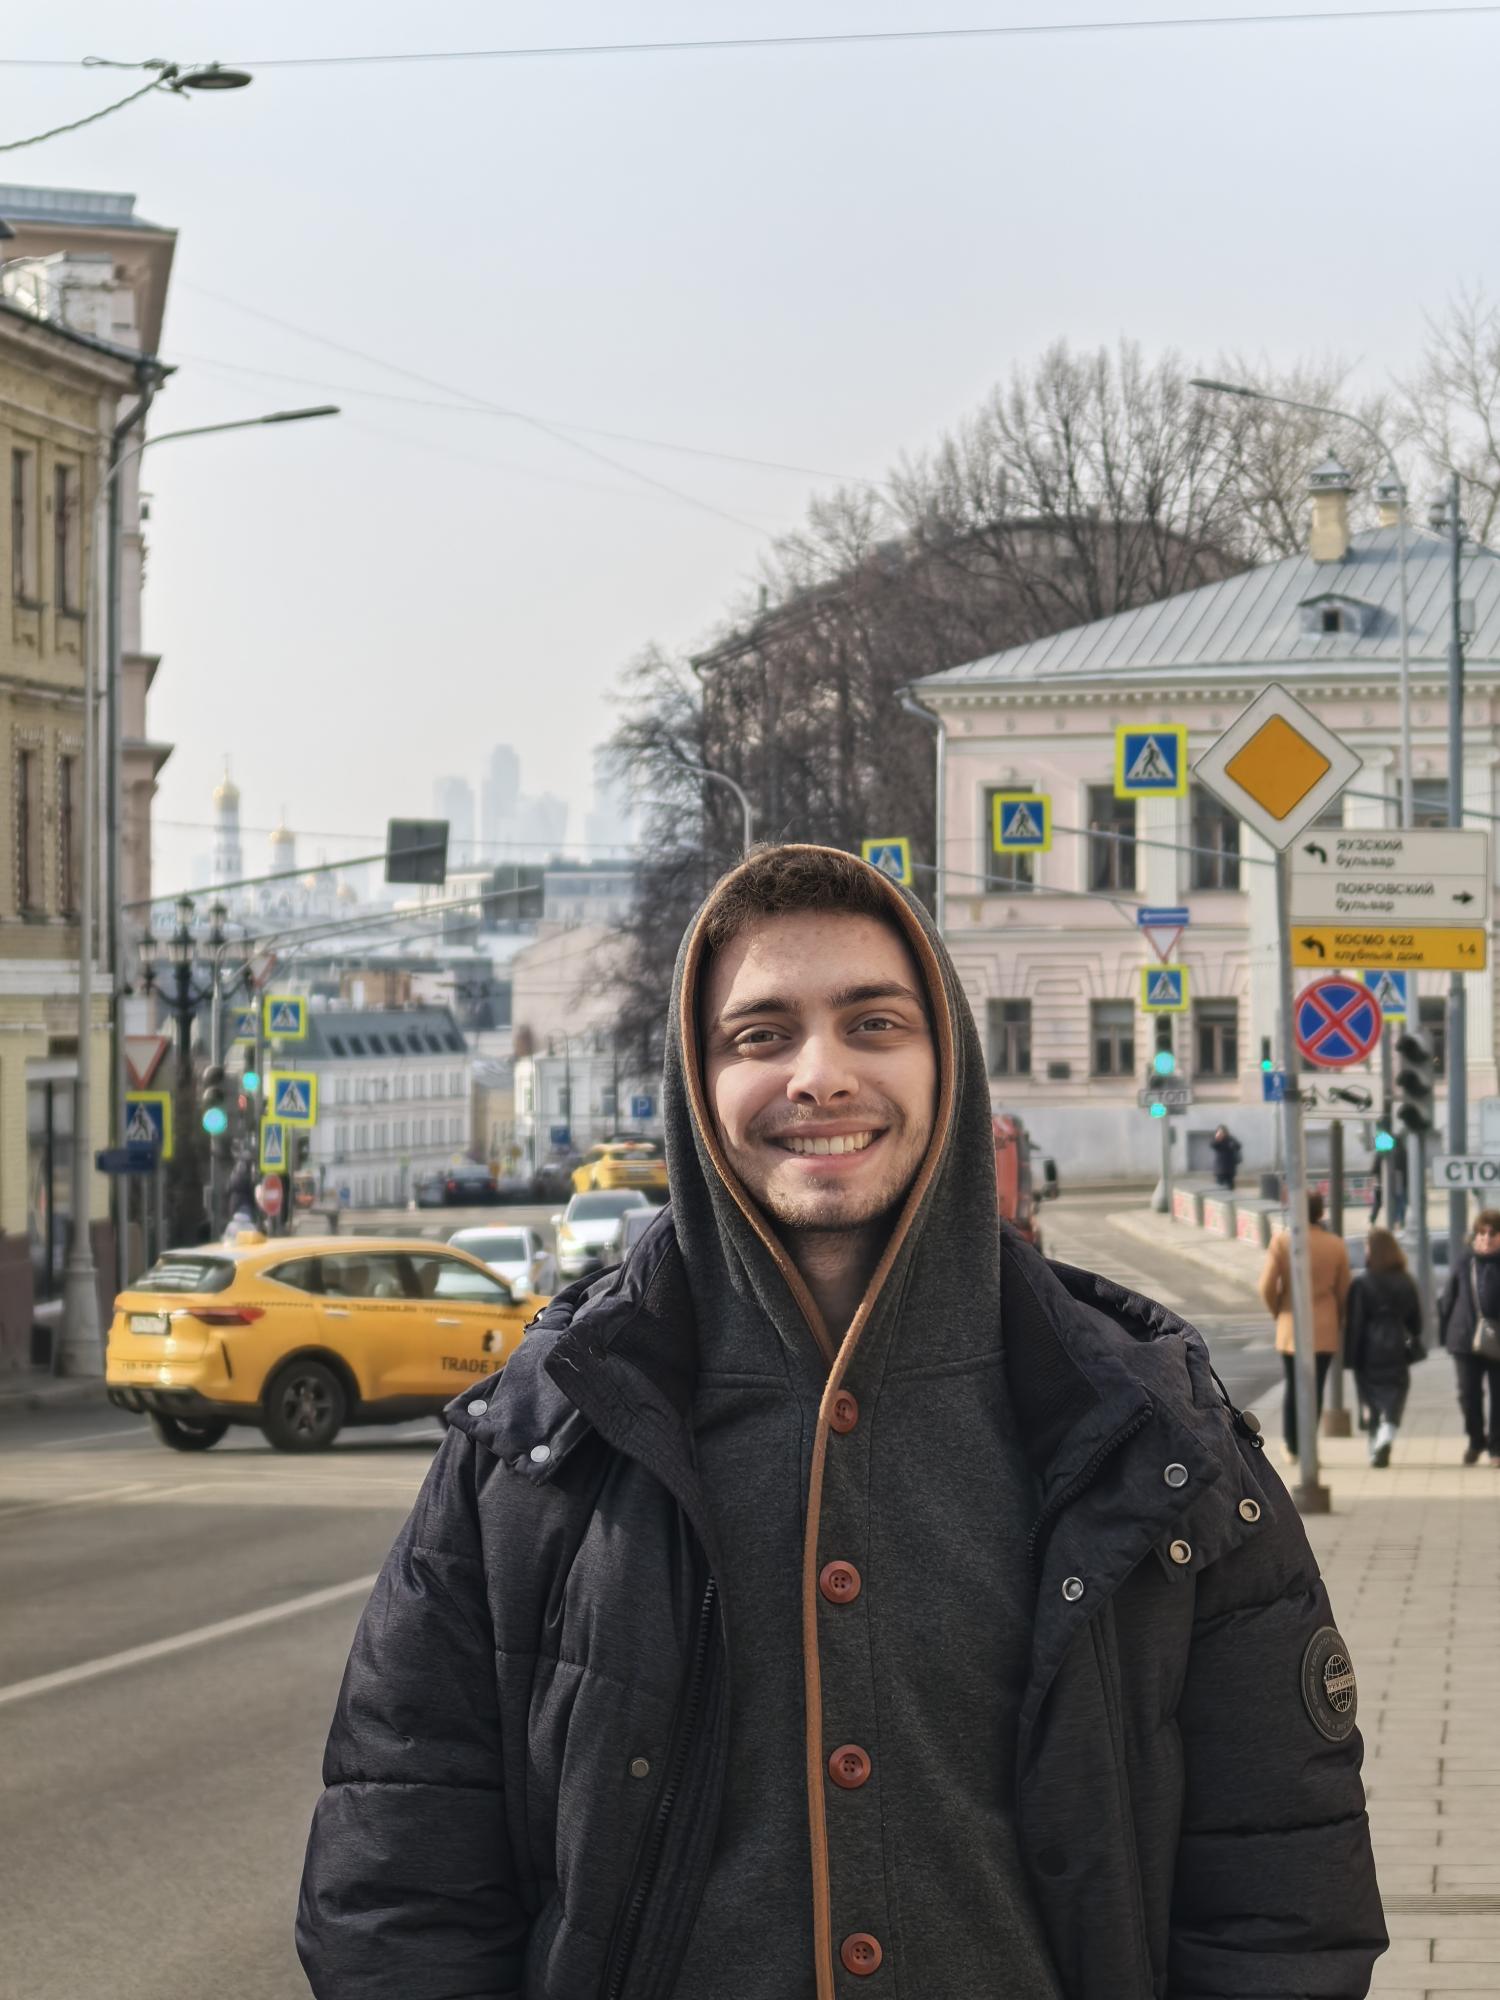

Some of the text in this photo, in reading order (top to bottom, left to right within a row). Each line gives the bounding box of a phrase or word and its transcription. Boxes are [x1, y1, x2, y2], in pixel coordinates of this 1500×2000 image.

[1336, 837, 1403, 851] ЯУЗСКИЙ
[1336, 854, 1395, 869] бульвар
[1336, 881, 1435, 895] ПОКРОВСКИЙ
[1336, 897, 1395, 912] бульвар
[1334, 934, 1385, 946] КОСМО
[1445, 1160, 1500, 1182] СТО
[441, 1356, 490, 1374] TRADE
